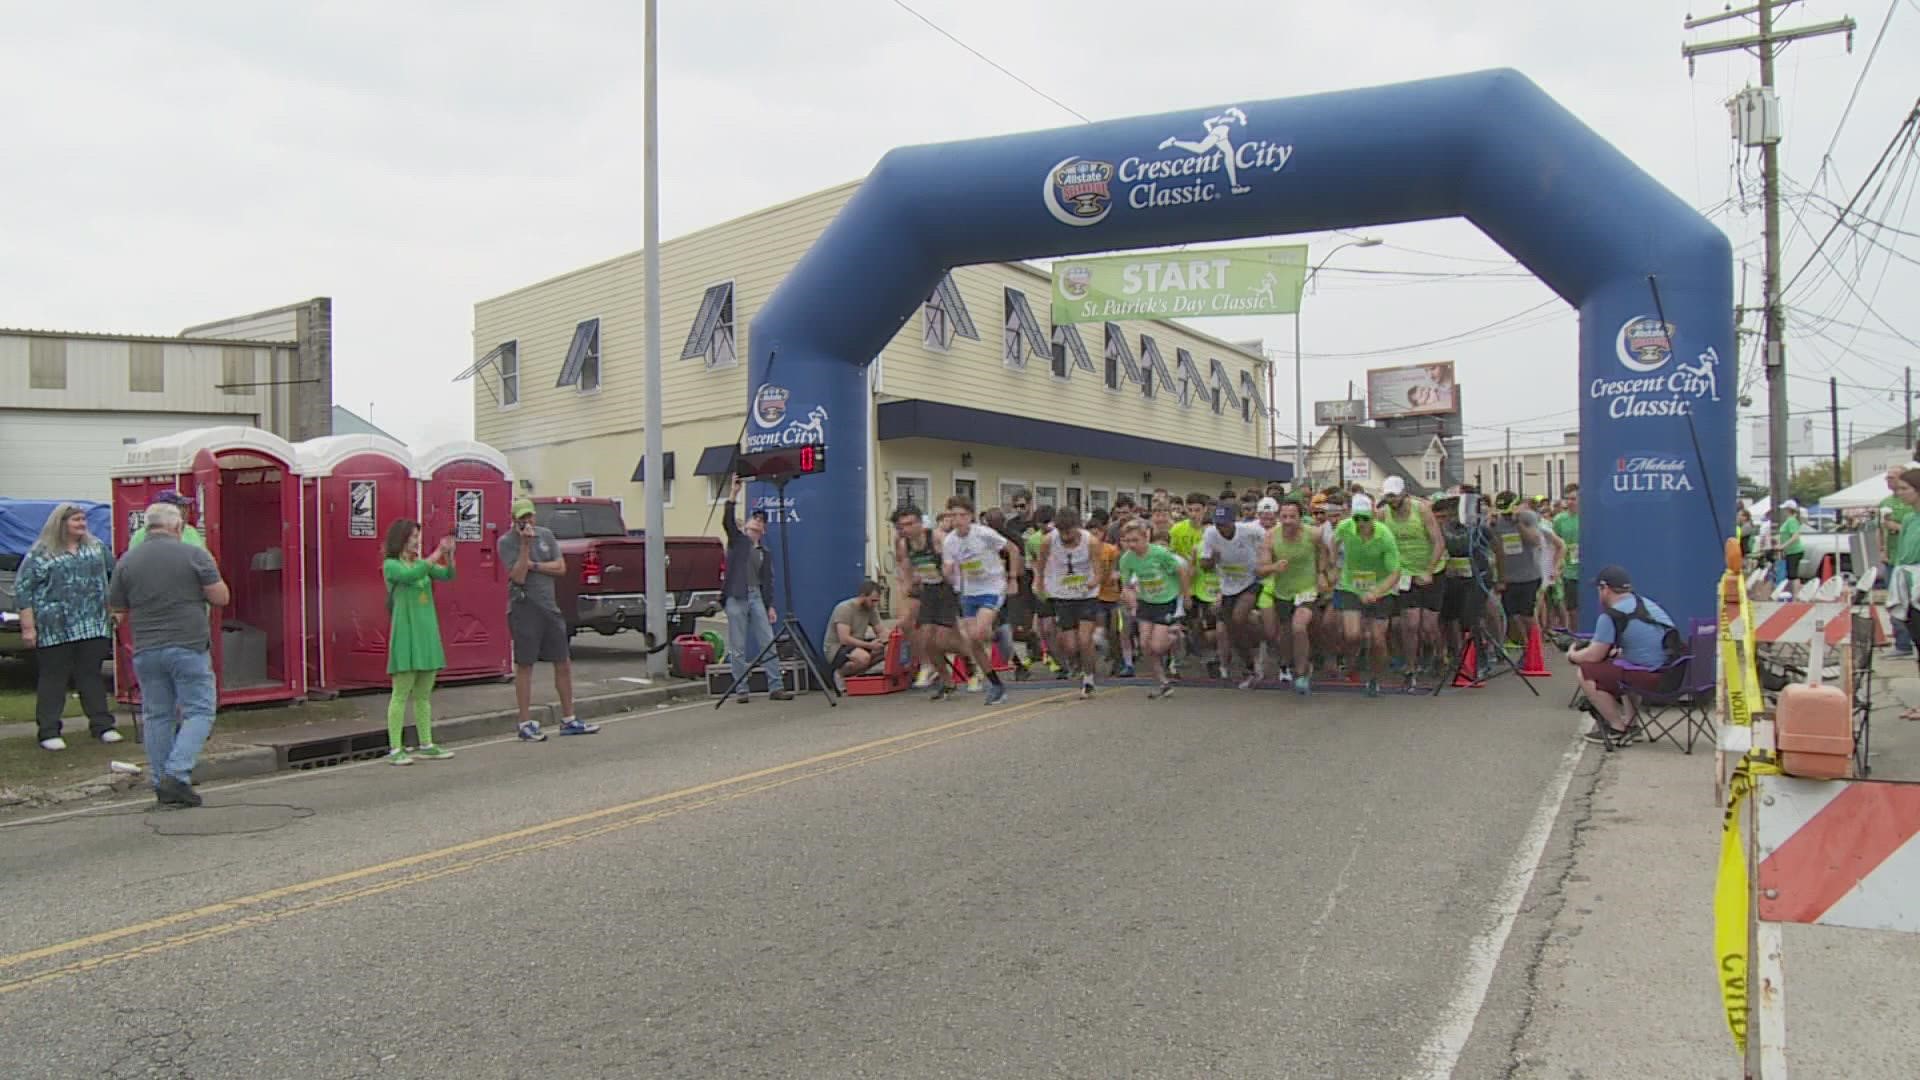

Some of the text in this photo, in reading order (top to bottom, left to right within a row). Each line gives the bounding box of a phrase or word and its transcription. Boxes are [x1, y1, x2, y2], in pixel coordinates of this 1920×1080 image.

[1118, 140, 1293, 183] Crescent City
[1128, 178, 1216, 209] Classic
[1121, 258, 1232, 295] START
[1080, 293, 1267, 318] St. Patrick's Day Classic
[1590, 371, 1711, 399] Crescent City
[1608, 394, 1690, 420] Classic
[1612, 473, 1694, 492] ULTRA
